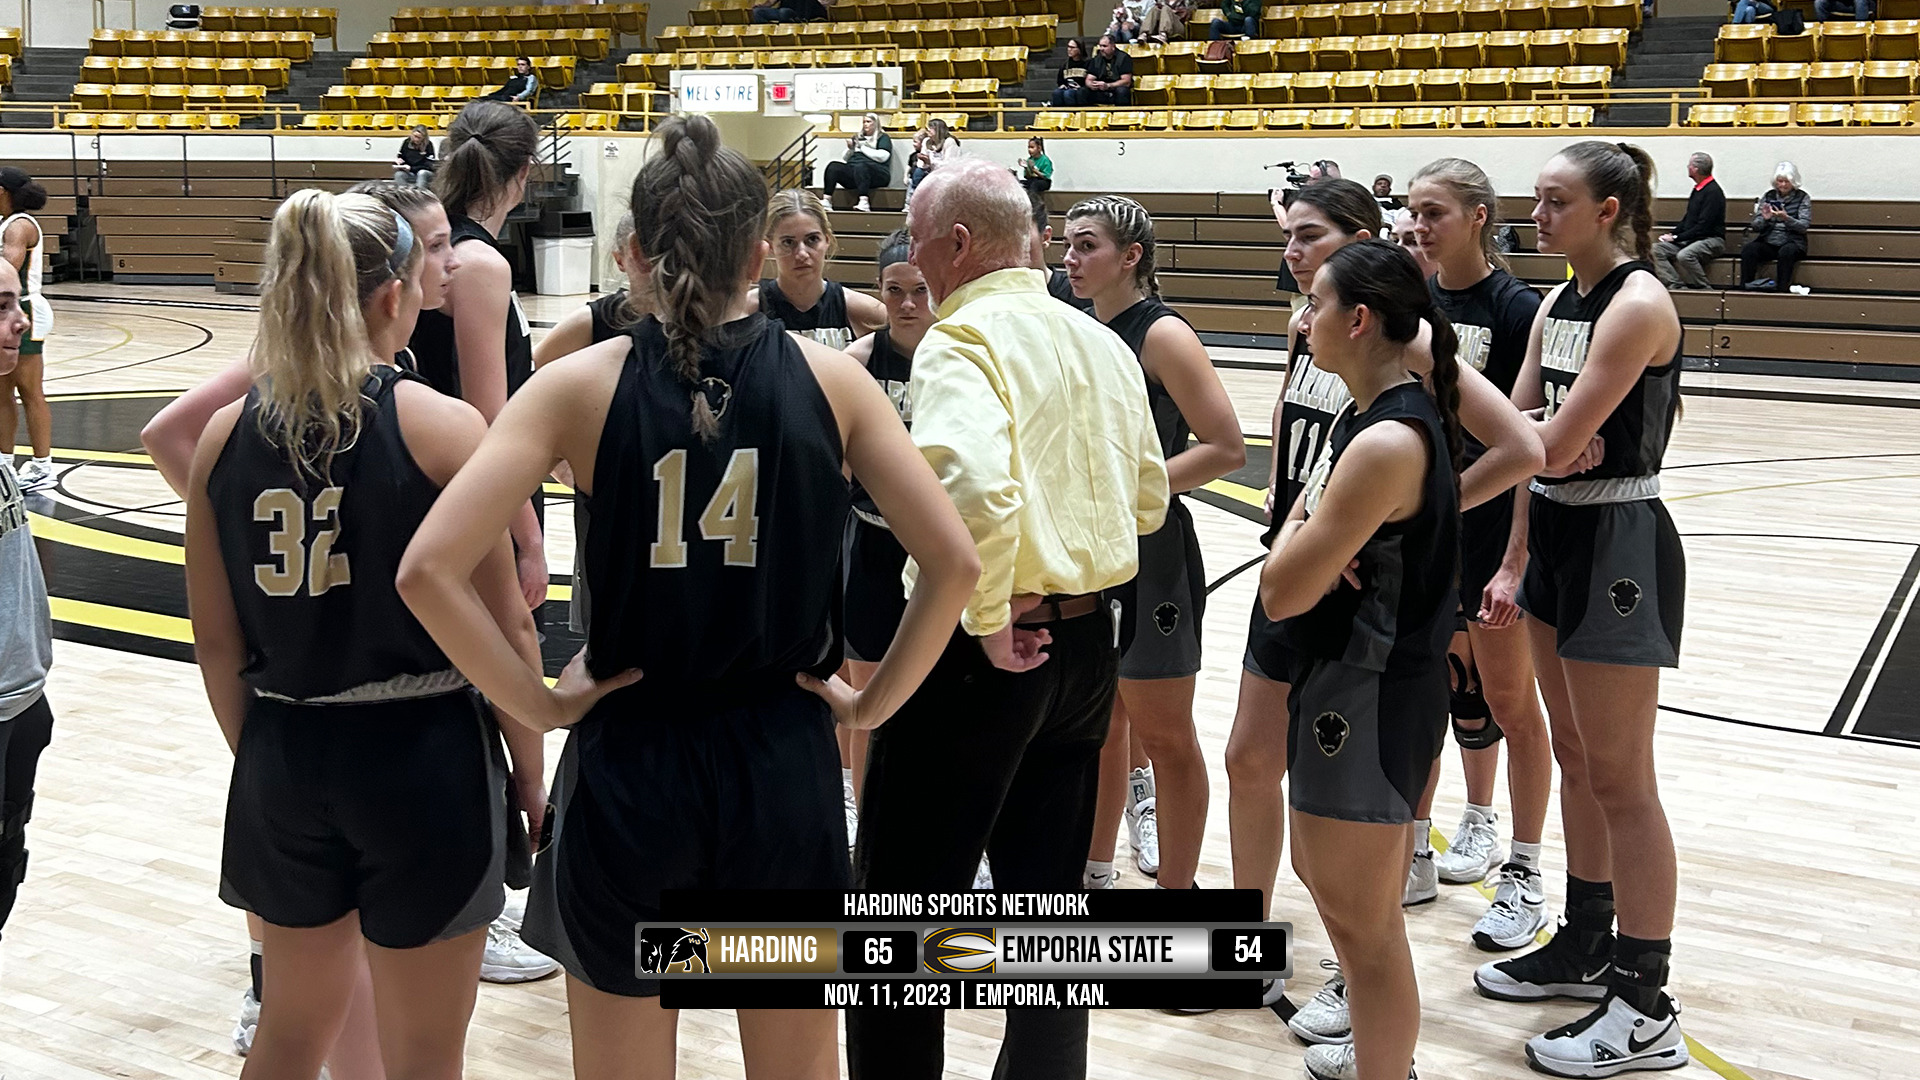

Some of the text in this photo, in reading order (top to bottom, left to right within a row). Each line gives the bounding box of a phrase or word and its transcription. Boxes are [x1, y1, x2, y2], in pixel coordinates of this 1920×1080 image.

[725, 85, 755, 101] TIRE
[365, 138, 372, 151] 5
[1117, 141, 1126, 156] 3
[118, 259, 126, 268] 6
[218, 267, 225, 276] 5
[1721, 335, 1731, 349] 2
[1287, 418, 1321, 484] 11
[650, 447, 760, 569] 14
[253, 486, 351, 597] 32
